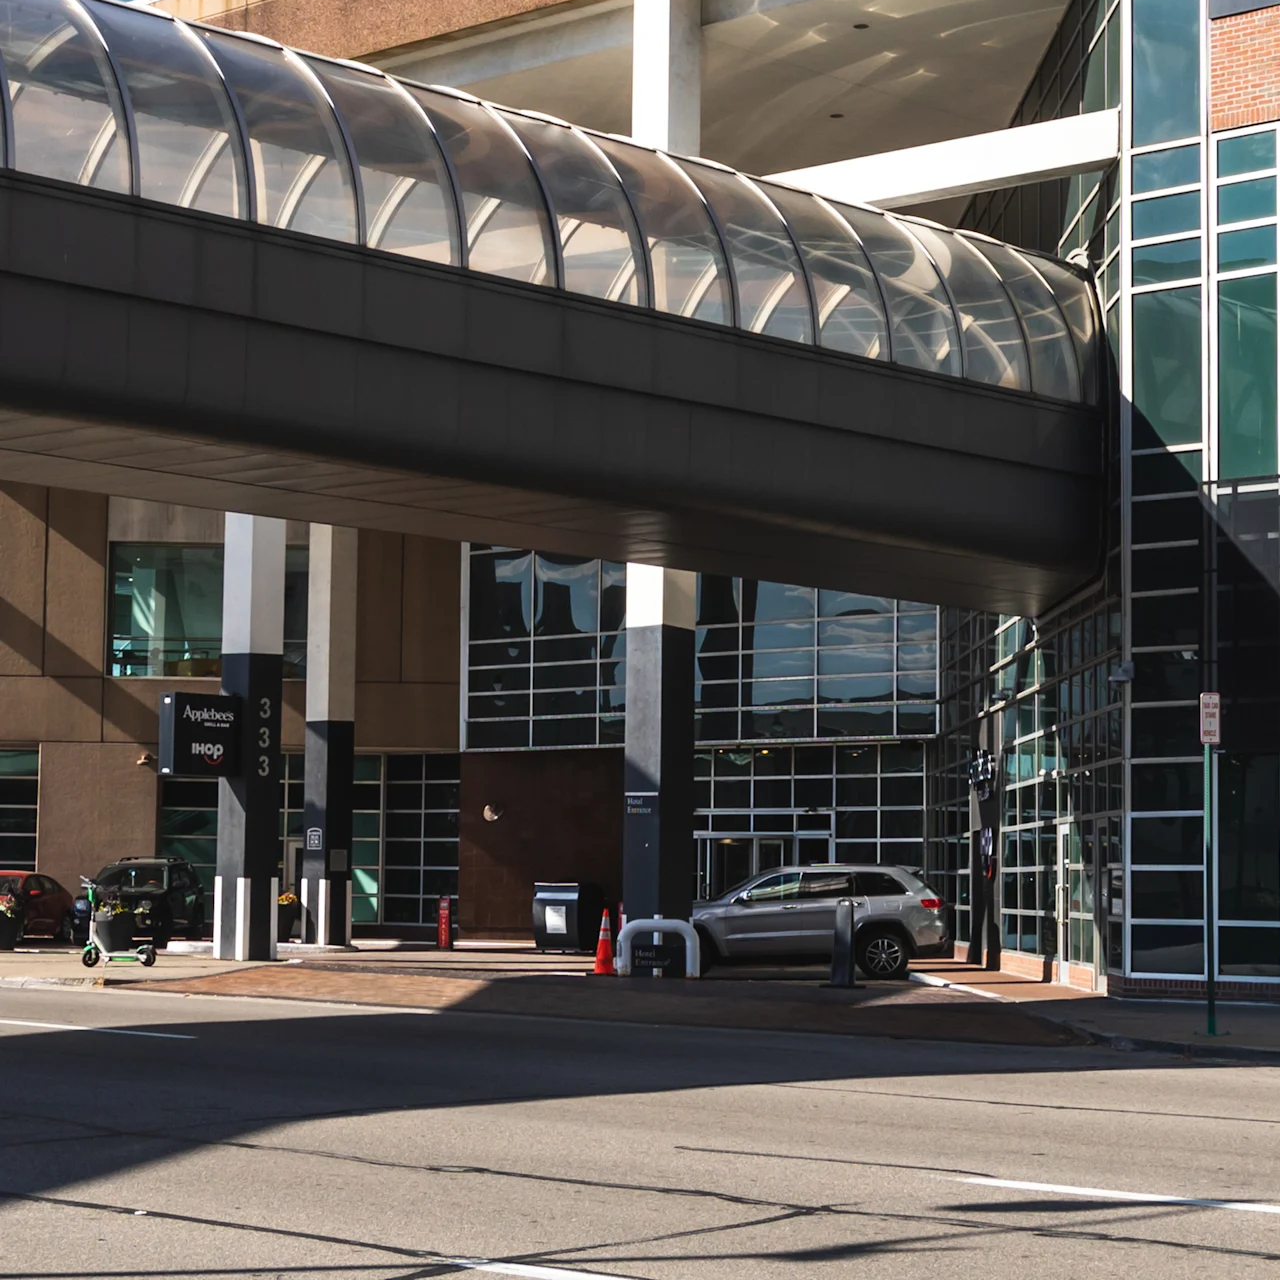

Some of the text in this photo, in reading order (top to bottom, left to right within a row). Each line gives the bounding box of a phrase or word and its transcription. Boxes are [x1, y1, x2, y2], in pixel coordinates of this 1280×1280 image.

[192, 742, 224, 759] IHOP
[627, 797, 643, 805] Hotel
[627, 806, 651, 814] Entrance
[635, 949, 656, 957] Hotel
[635, 958, 669, 967] Entrance
